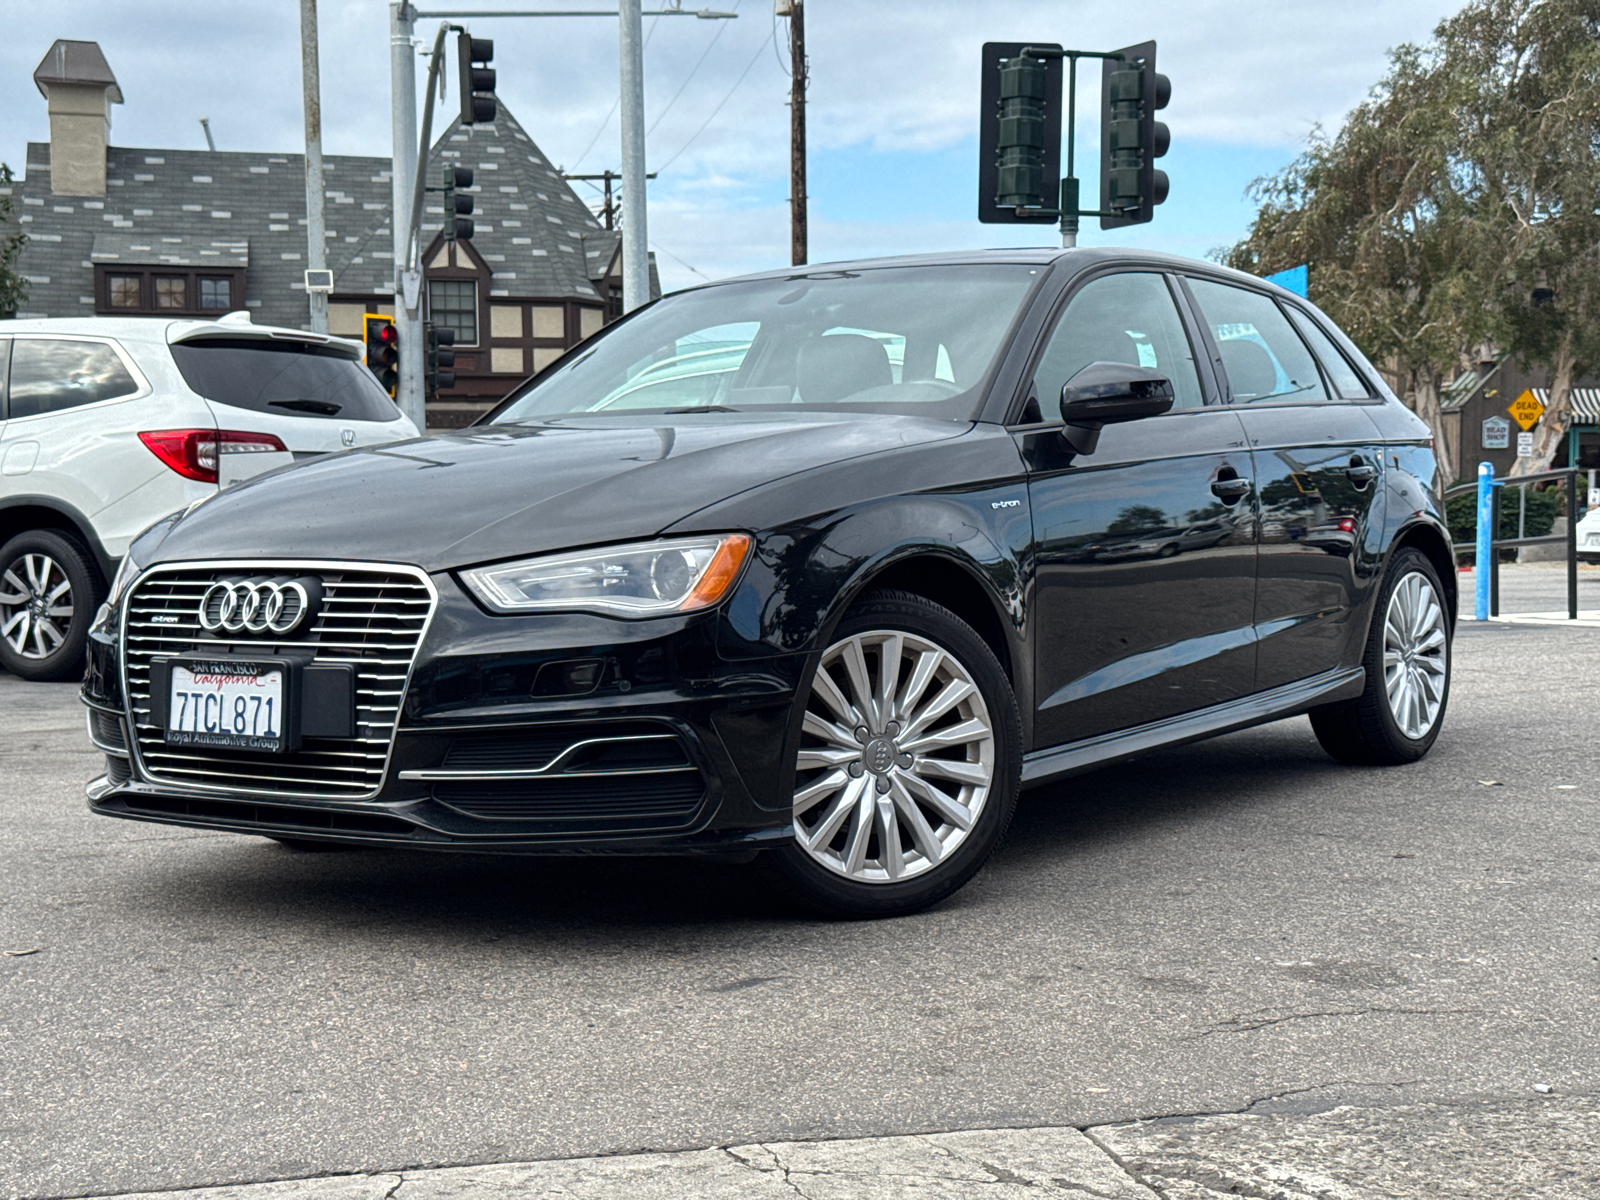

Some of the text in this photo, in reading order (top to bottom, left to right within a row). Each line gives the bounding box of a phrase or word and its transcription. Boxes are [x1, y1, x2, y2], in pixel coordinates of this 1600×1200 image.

[1516, 401, 1537, 410] DEAD
[1518, 412, 1534, 421] END
[991, 500, 1020, 509] e-tron
[193, 660, 257, 675] SAN FRANCISCO
[193, 674, 265, 690] California
[176, 691, 277, 737] 7TCL871
[167, 731, 279, 752] Royal Automotive Group
